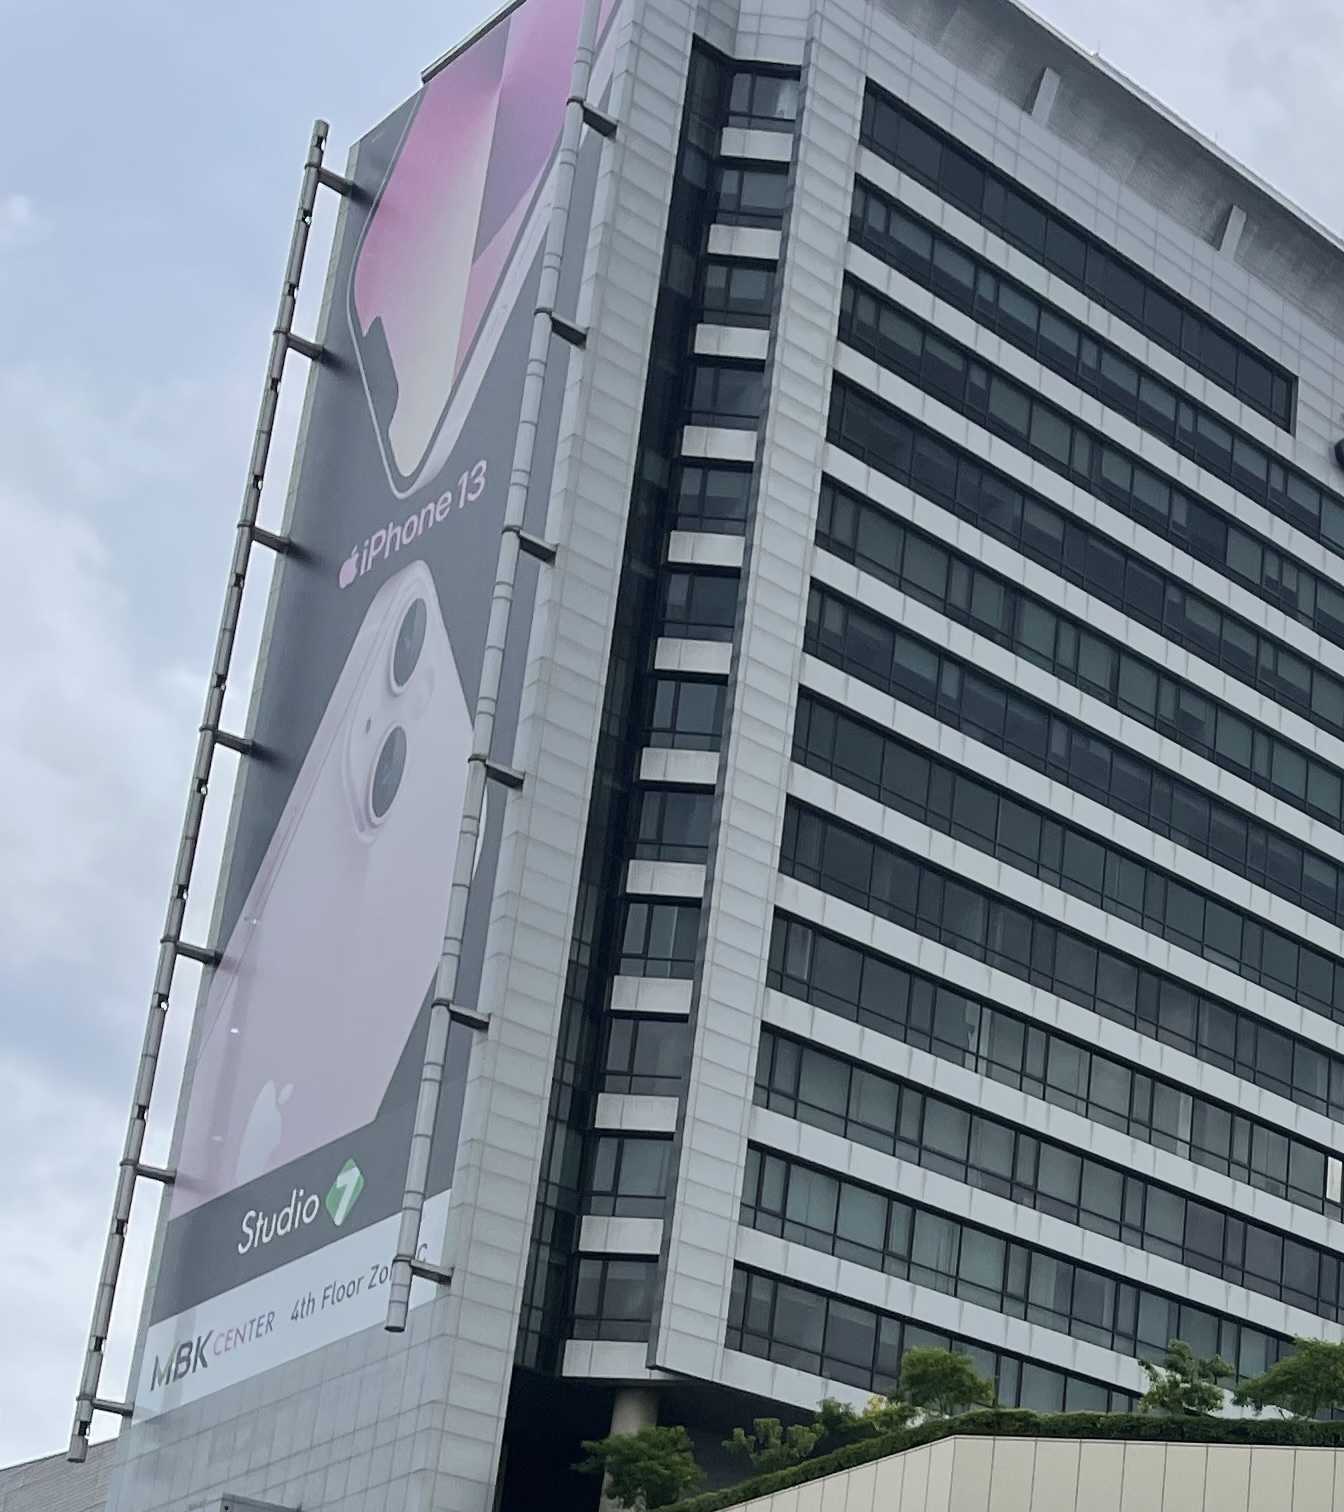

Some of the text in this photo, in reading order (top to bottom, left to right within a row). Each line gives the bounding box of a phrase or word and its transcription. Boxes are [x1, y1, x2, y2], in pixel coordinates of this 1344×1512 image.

[359, 459, 488, 574] iPhone 13
[238, 1189, 319, 1255] Studio
[150, 1330, 212, 1391] MBK
[213, 1312, 275, 1356] CENTER
[290, 1298, 316, 1322] 4th
[321, 1278, 362, 1310] Floor
